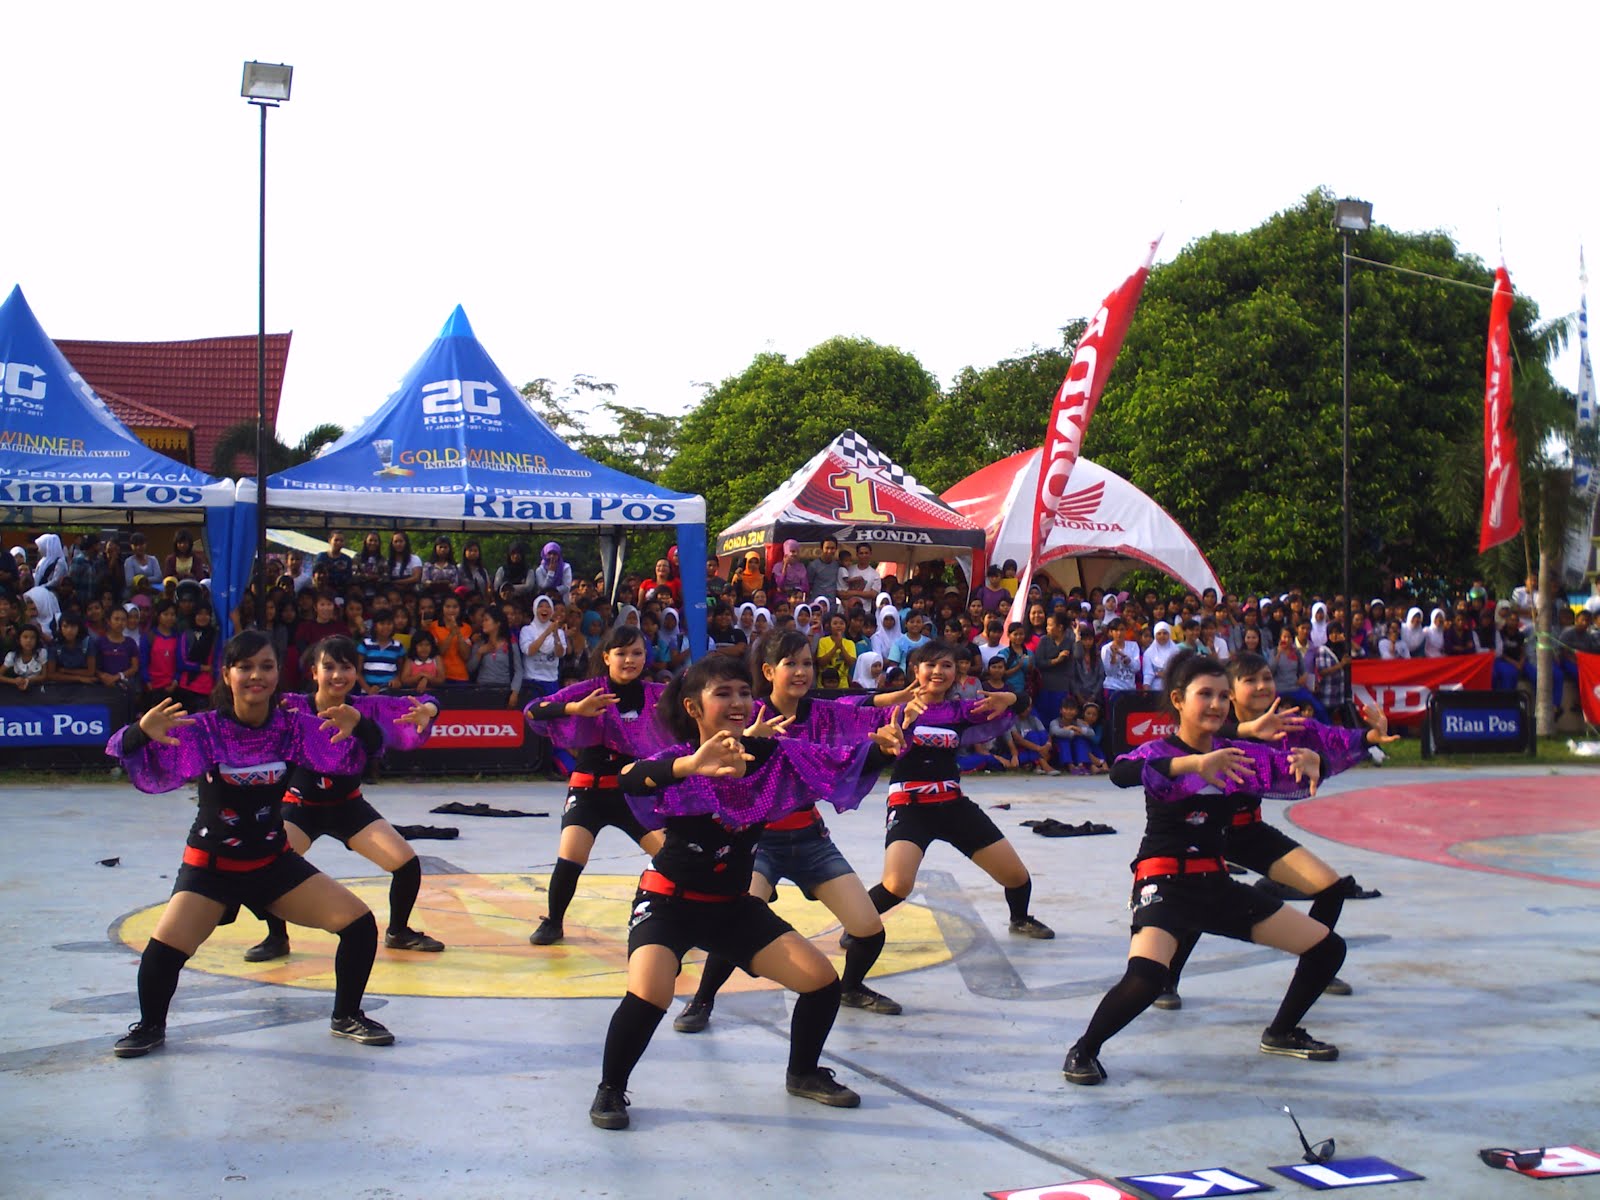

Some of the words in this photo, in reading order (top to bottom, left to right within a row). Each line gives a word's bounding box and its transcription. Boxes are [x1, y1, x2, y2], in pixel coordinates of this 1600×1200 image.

[424, 414, 466, 425] Riau
[469, 415, 503, 426] Pos
[400, 447, 460, 465] GOLD
[464, 445, 548, 469] WINNER
[17, 469, 112, 479] PERTAMA
[117, 471, 192, 482] DIBACA
[552, 468, 592, 477] AWARD
[112, 483, 203, 504] Pos
[281, 476, 382, 492] TERBESAR
[389, 483, 488, 493] TERDEPAN
[494, 487, 583, 497] PERTAMA
[588, 491, 658, 499] DIBACA
[463, 491, 573, 519] Riau
[589, 498, 676, 521] Pos
[1054, 519, 1126, 532] HONDA
[855, 529, 934, 544] HONDA
[53, 714, 104, 736] Pos
[430, 724, 517, 737] HONDA
[1446, 715, 1485, 732] Riau
[1488, 715, 1517, 732] Pos
